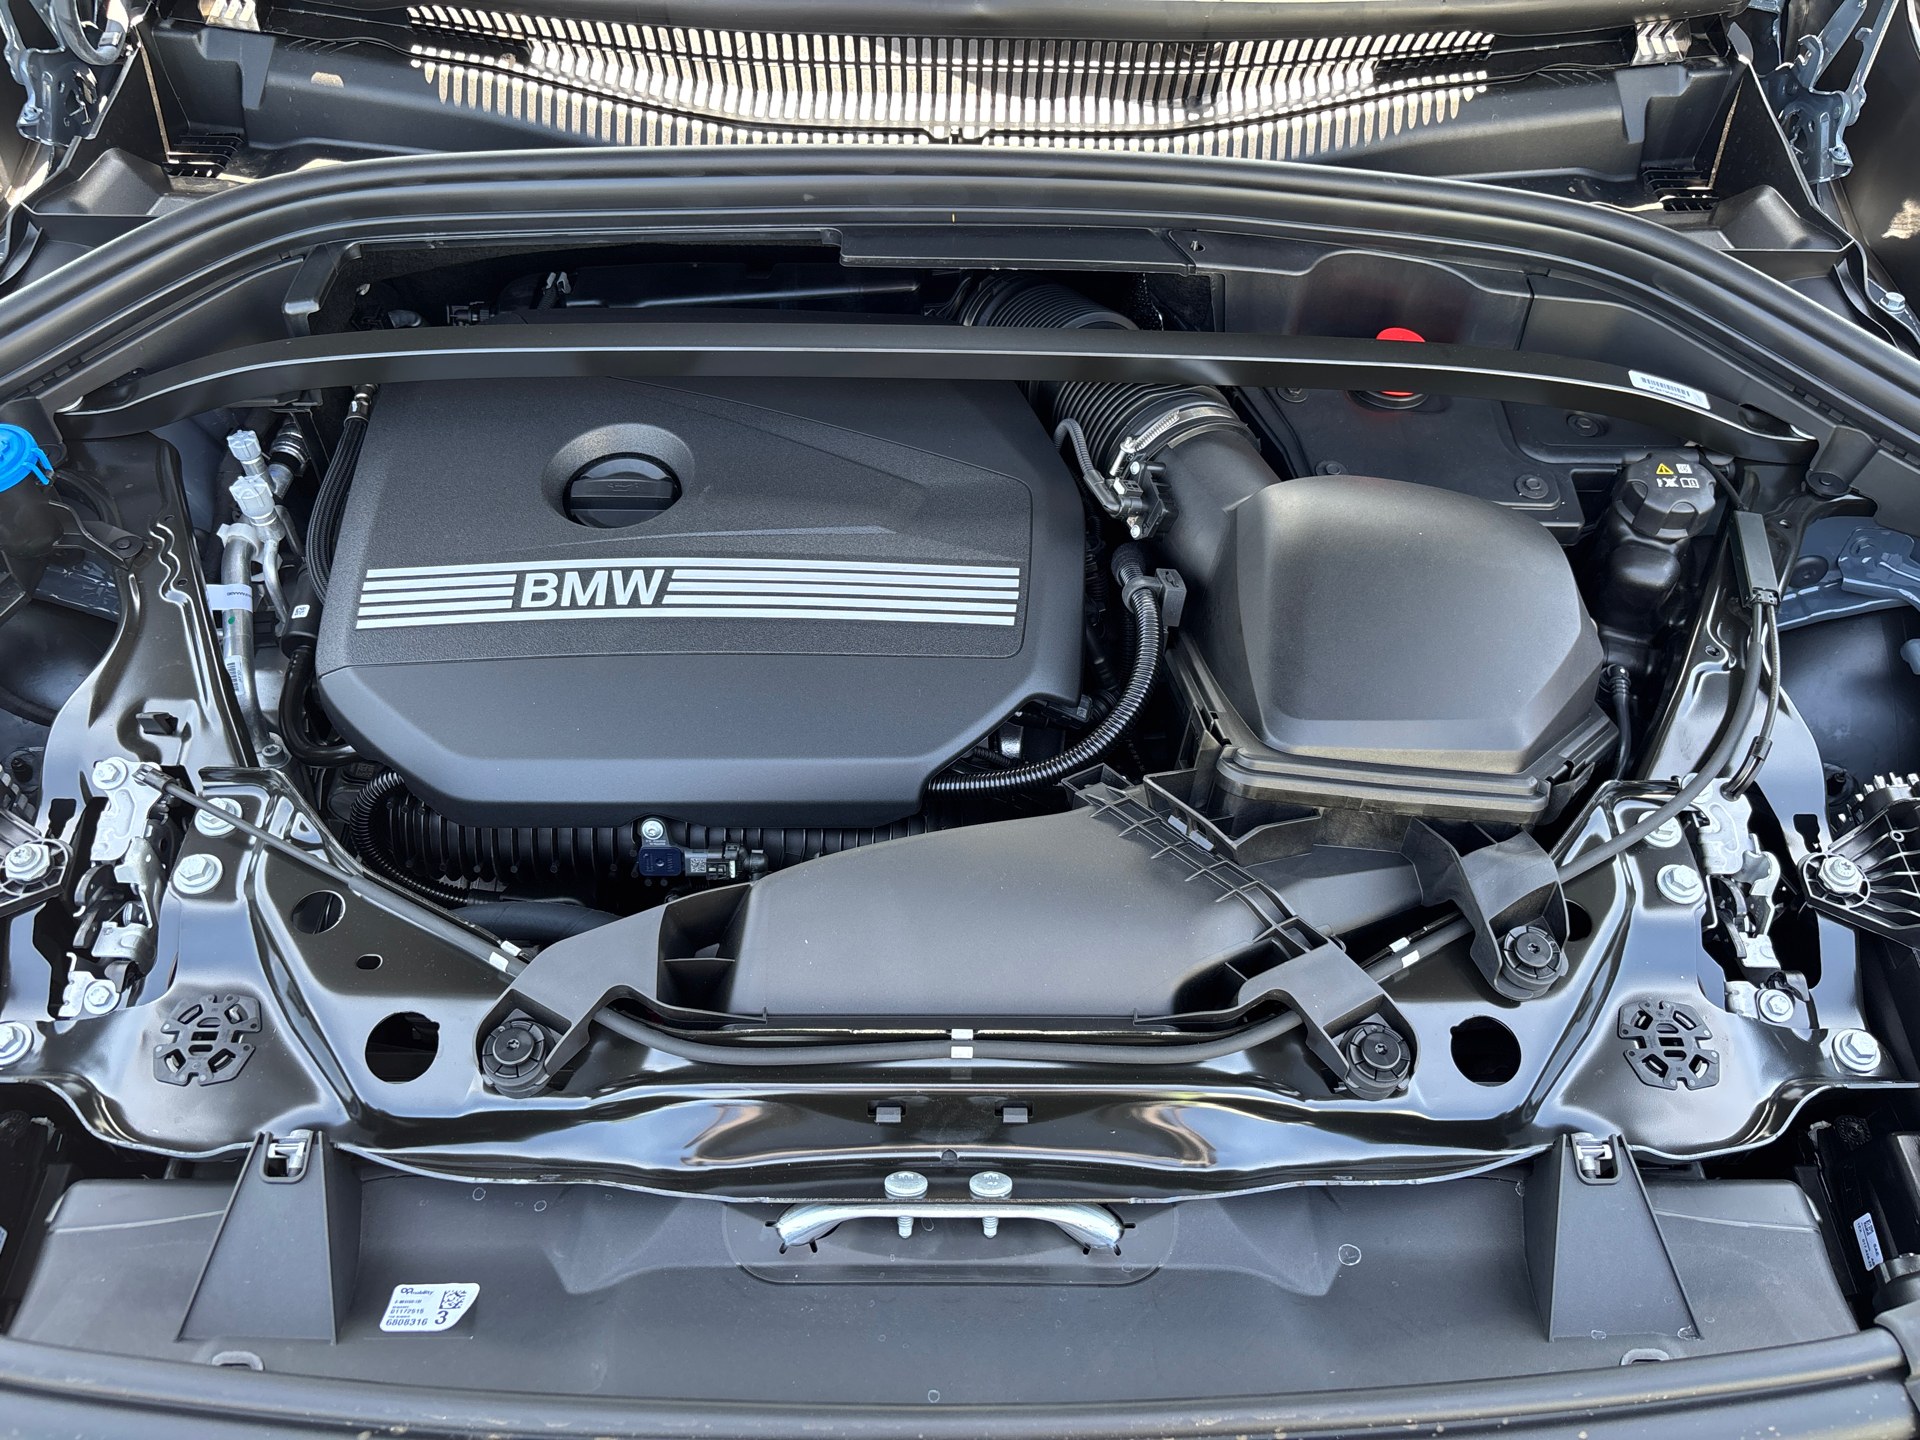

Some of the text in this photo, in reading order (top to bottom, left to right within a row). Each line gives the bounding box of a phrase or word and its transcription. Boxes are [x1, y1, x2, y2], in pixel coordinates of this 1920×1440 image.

[520, 569, 665, 608] BMW
[385, 1318, 429, 1326] 6808316
[434, 1310, 449, 1325] 3
